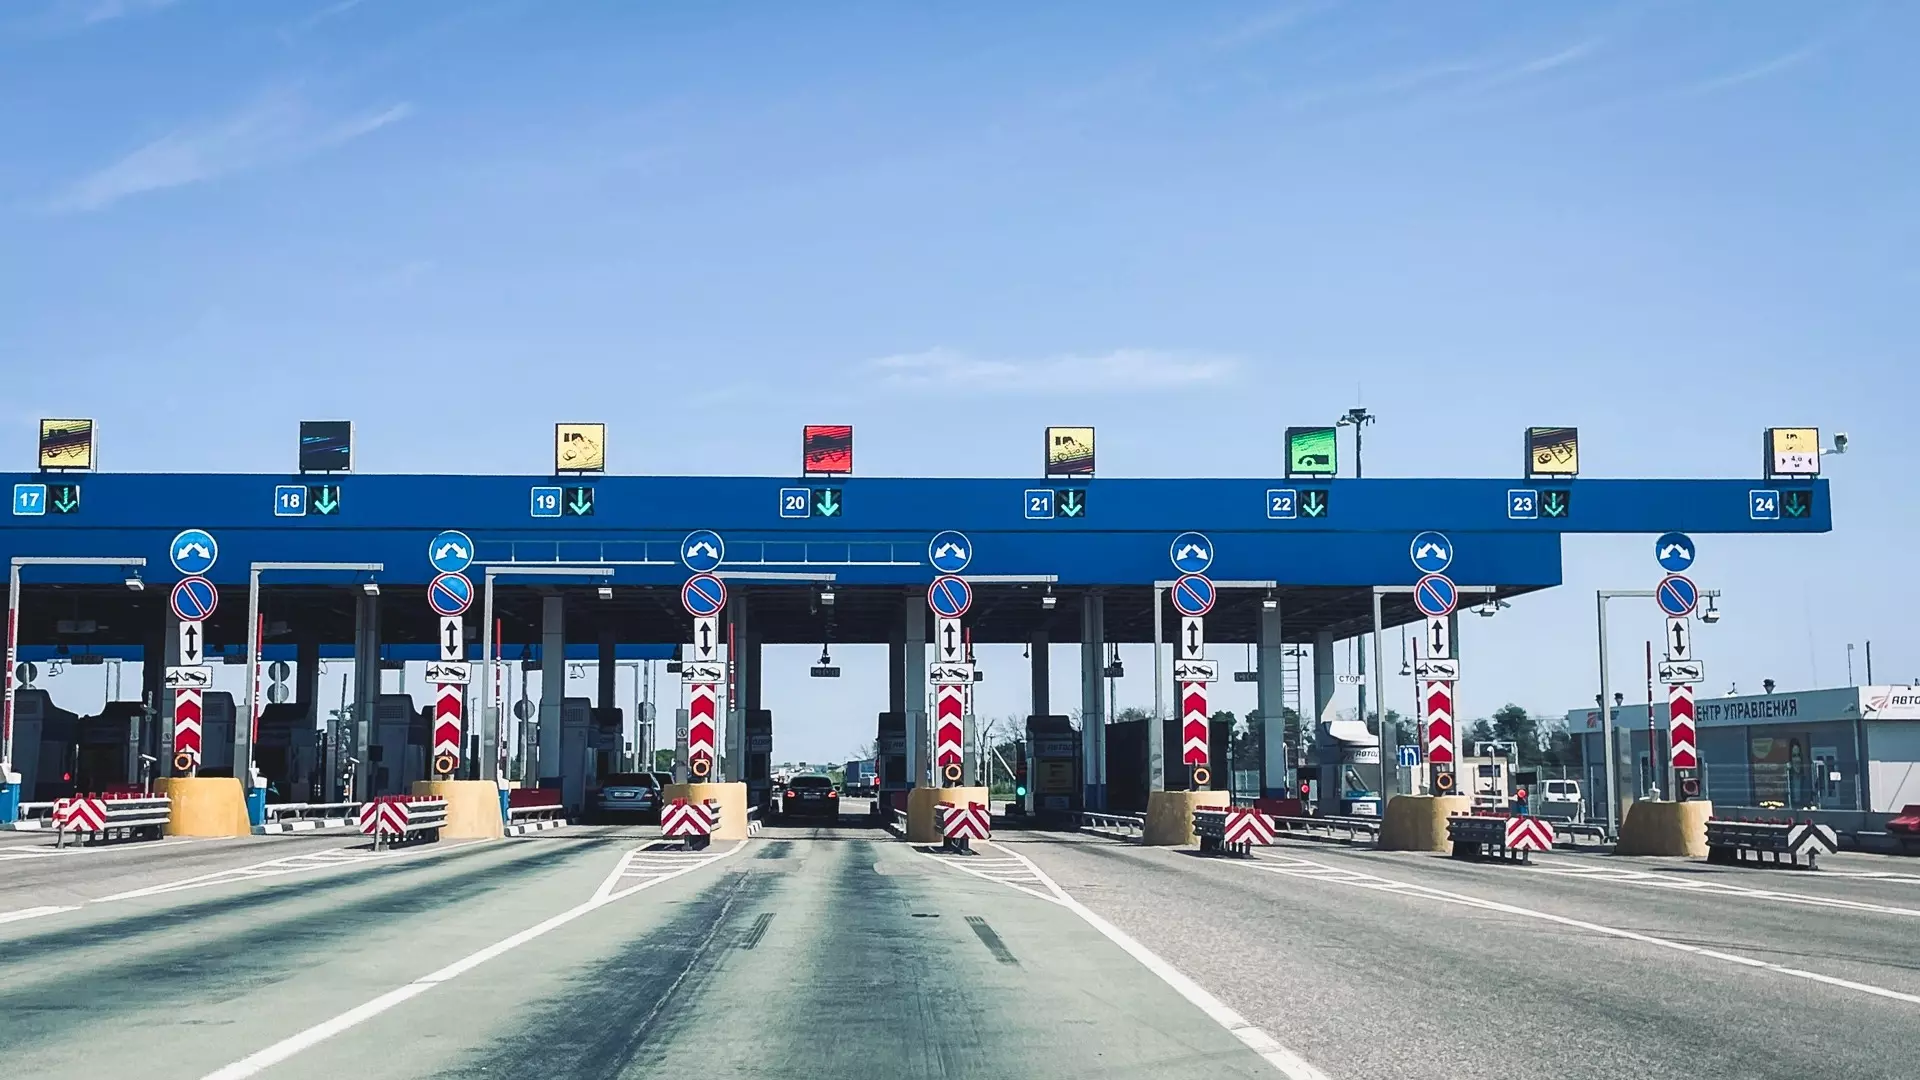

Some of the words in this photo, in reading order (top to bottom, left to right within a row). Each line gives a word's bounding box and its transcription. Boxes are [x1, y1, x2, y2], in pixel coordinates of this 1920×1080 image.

[20, 492, 40, 507] 17
[280, 493, 300, 508] 18
[536, 495, 556, 509] 19
[785, 496, 805, 510] 20
[1031, 497, 1049, 511] 21
[1273, 497, 1291, 511] 22
[1513, 497, 1533, 511] 23
[1755, 497, 1775, 512] 24
[1696, 704, 1721, 721] ЕНТР
[1724, 699, 1797, 719] УПРАВЛЕНИЯ
